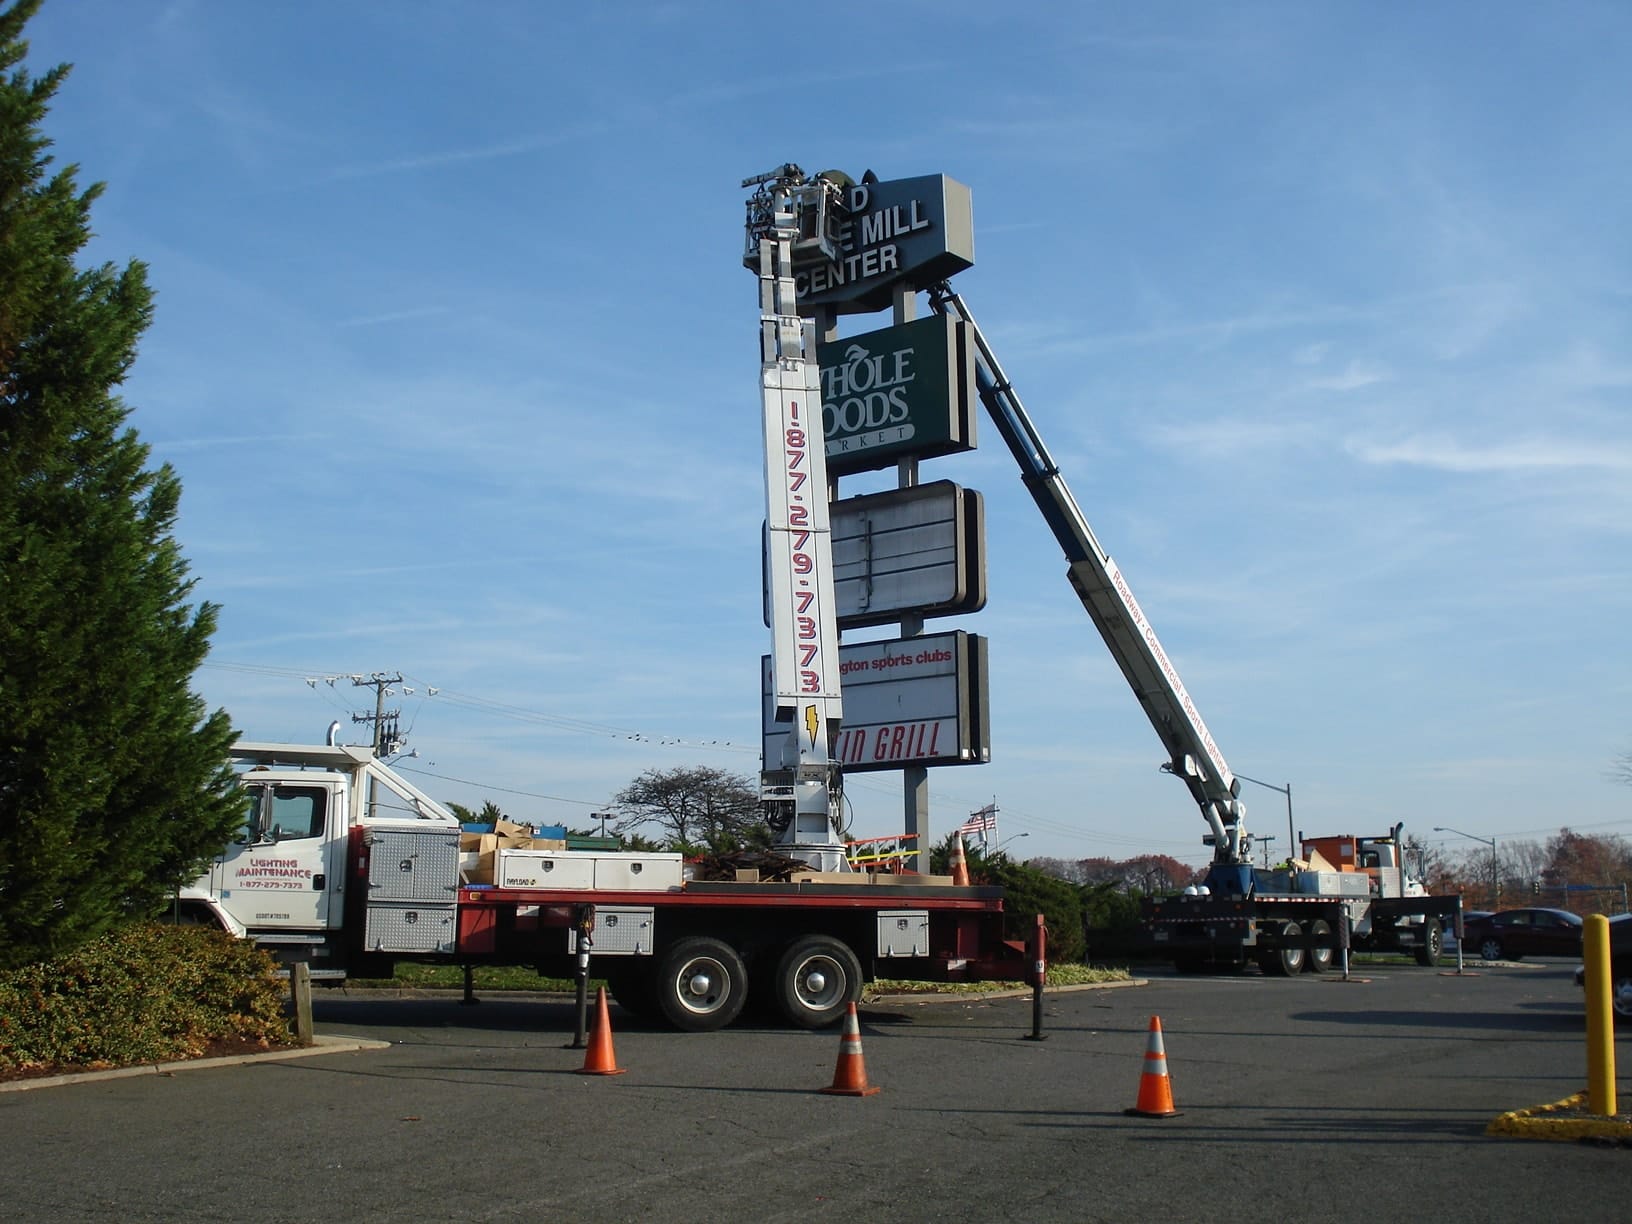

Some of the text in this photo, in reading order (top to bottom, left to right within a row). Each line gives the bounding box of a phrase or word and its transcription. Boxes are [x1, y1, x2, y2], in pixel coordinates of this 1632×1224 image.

[862, 200, 928, 246] MILL
[795, 244, 898, 298] CENTER
[820, 346, 915, 400] HOLE
[823, 386, 909, 438] OODS
[825, 427, 904, 454] ARKET
[839, 649, 952, 675] gton sports clubs
[1113, 571, 1227, 777] Roadway Commercial Sports Lighting
[835, 722, 939, 762] IN GRILL
[236, 868, 311, 879] MAINTENANCE
[250, 859, 298, 868] LIGHTING
